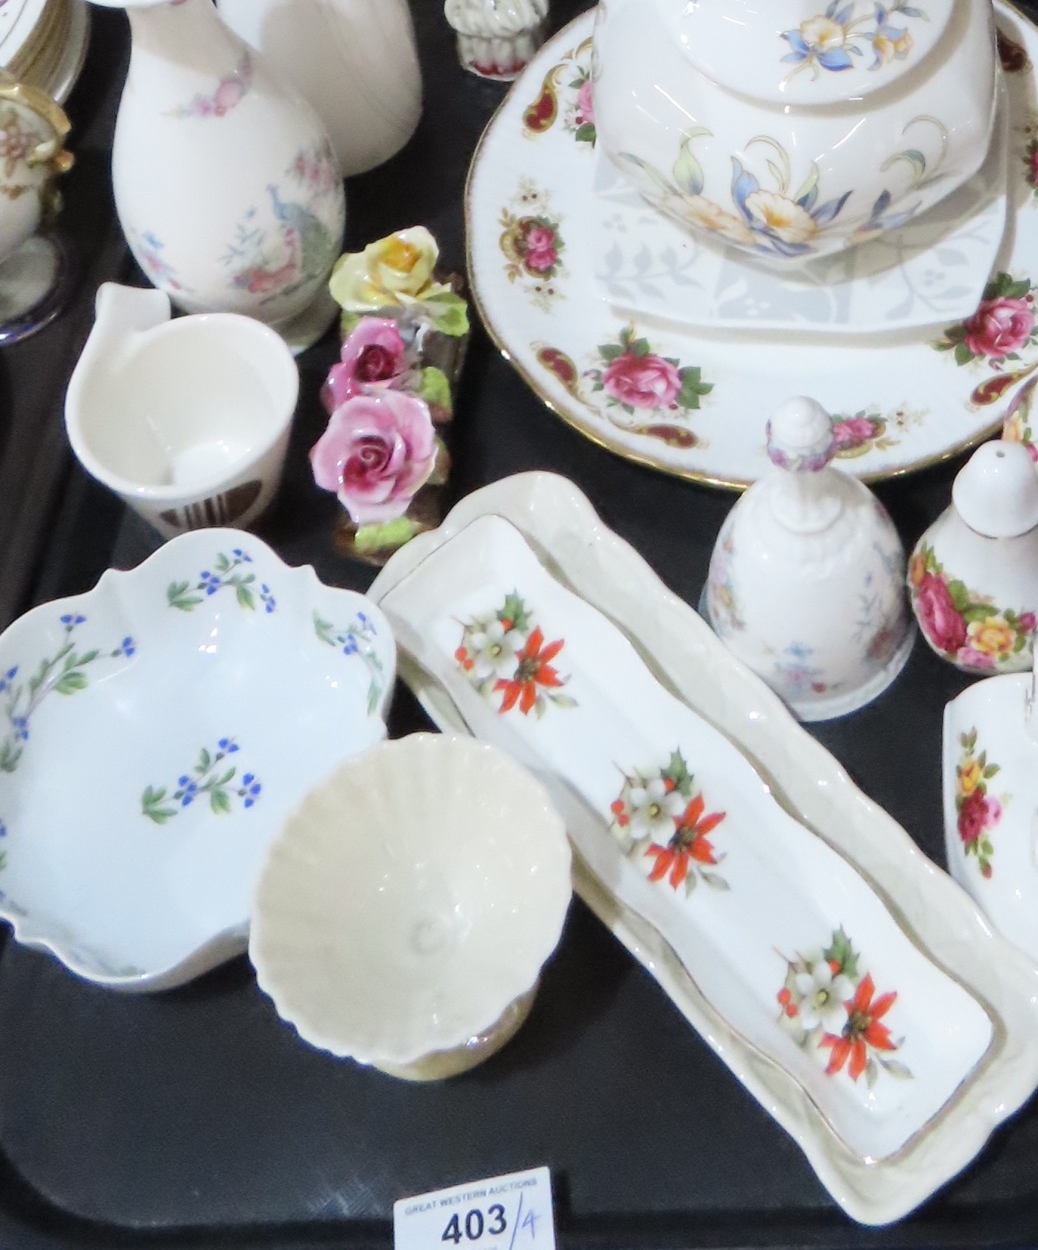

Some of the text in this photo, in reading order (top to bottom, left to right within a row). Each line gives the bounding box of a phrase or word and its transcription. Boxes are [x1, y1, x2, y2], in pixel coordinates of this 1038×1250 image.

[404, 1178, 537, 1215] GREAT WESTERN AUCTIONS
